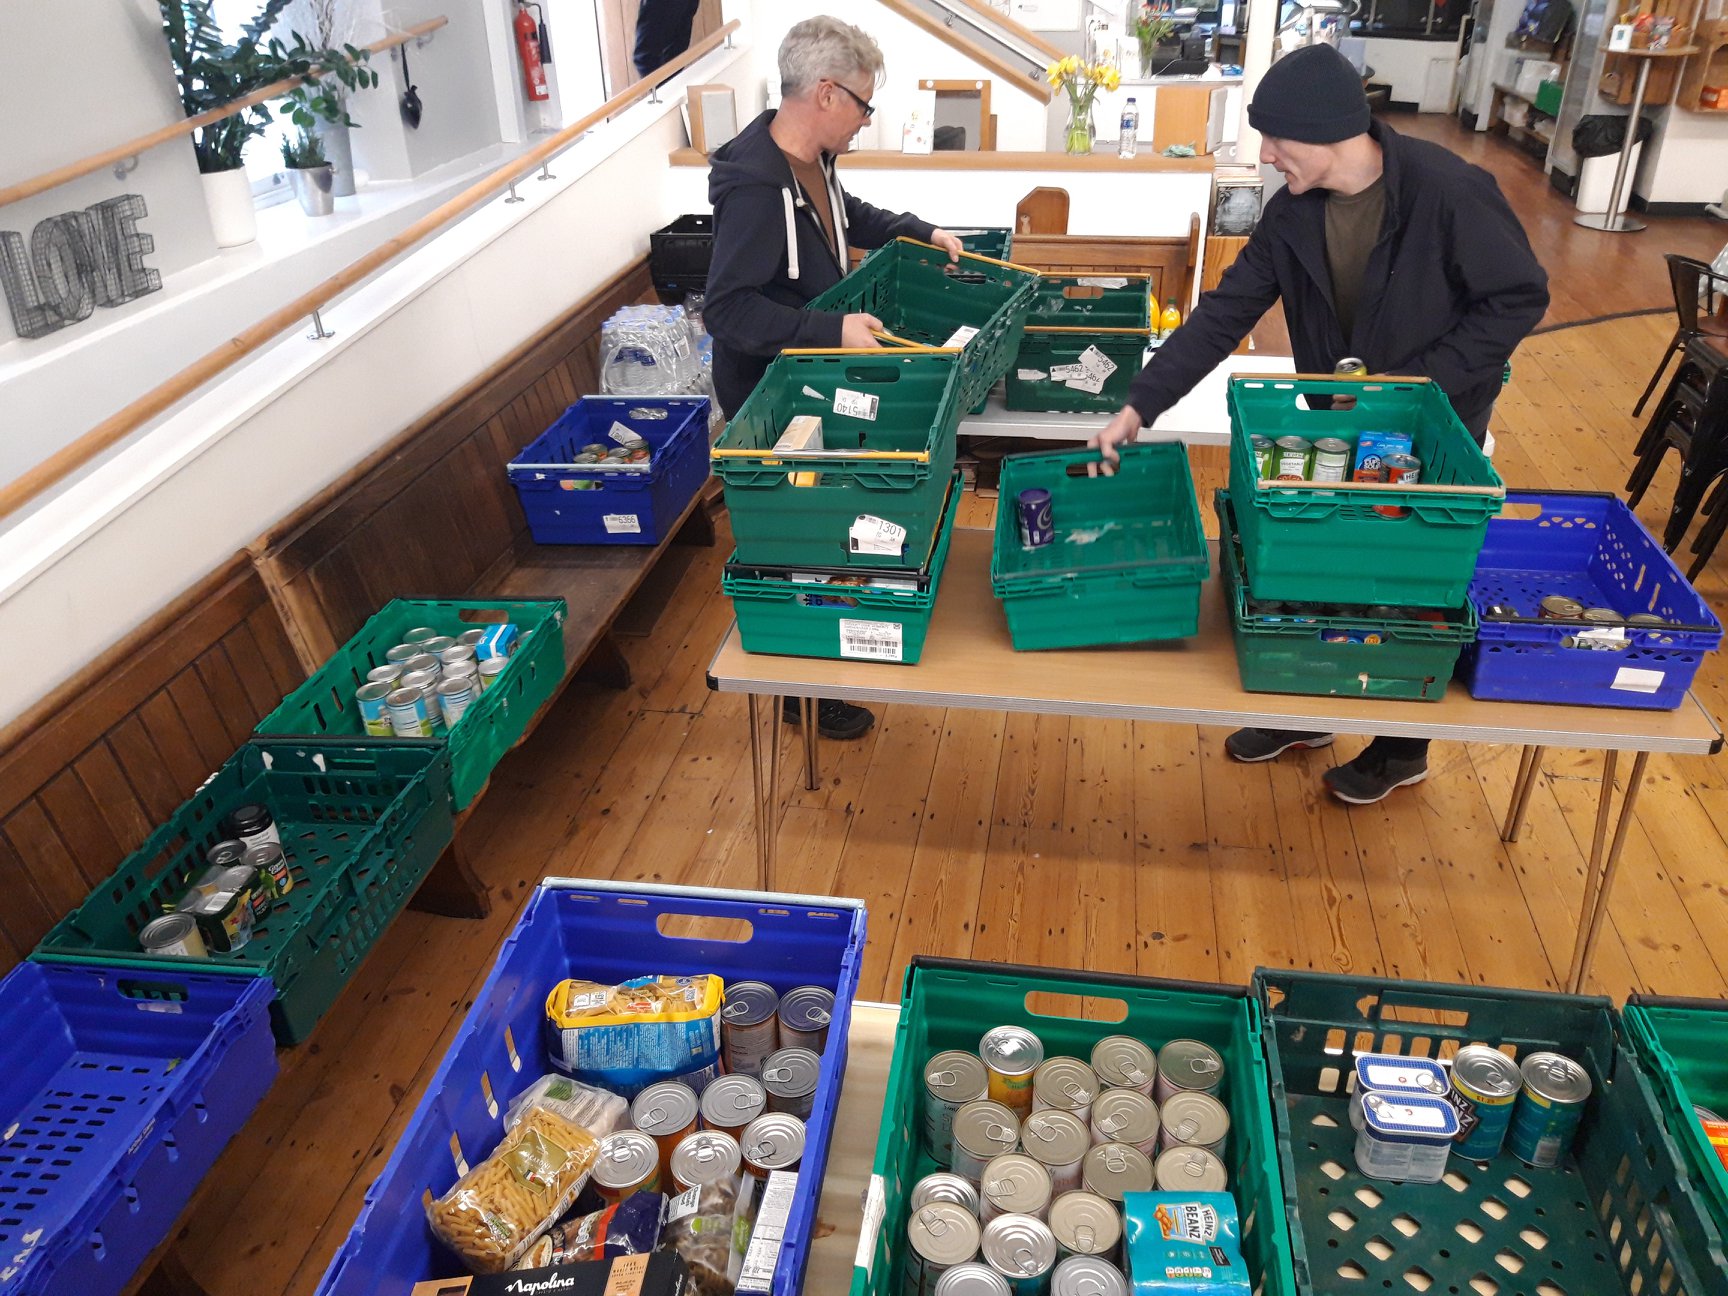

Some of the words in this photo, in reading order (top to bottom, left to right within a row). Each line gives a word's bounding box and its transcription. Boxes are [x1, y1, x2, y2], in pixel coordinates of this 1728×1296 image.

[0, 194, 163, 339] LOVE
[1098, 355, 1115, 372] 5462
[879, 520, 902, 537] 1301
[1451, 1090, 1469, 1111] INZ
[1185, 1205, 1201, 1239] BEANZ
[1202, 1209, 1214, 1237] HEINZ
[504, 1272, 575, 1296] Napolina
